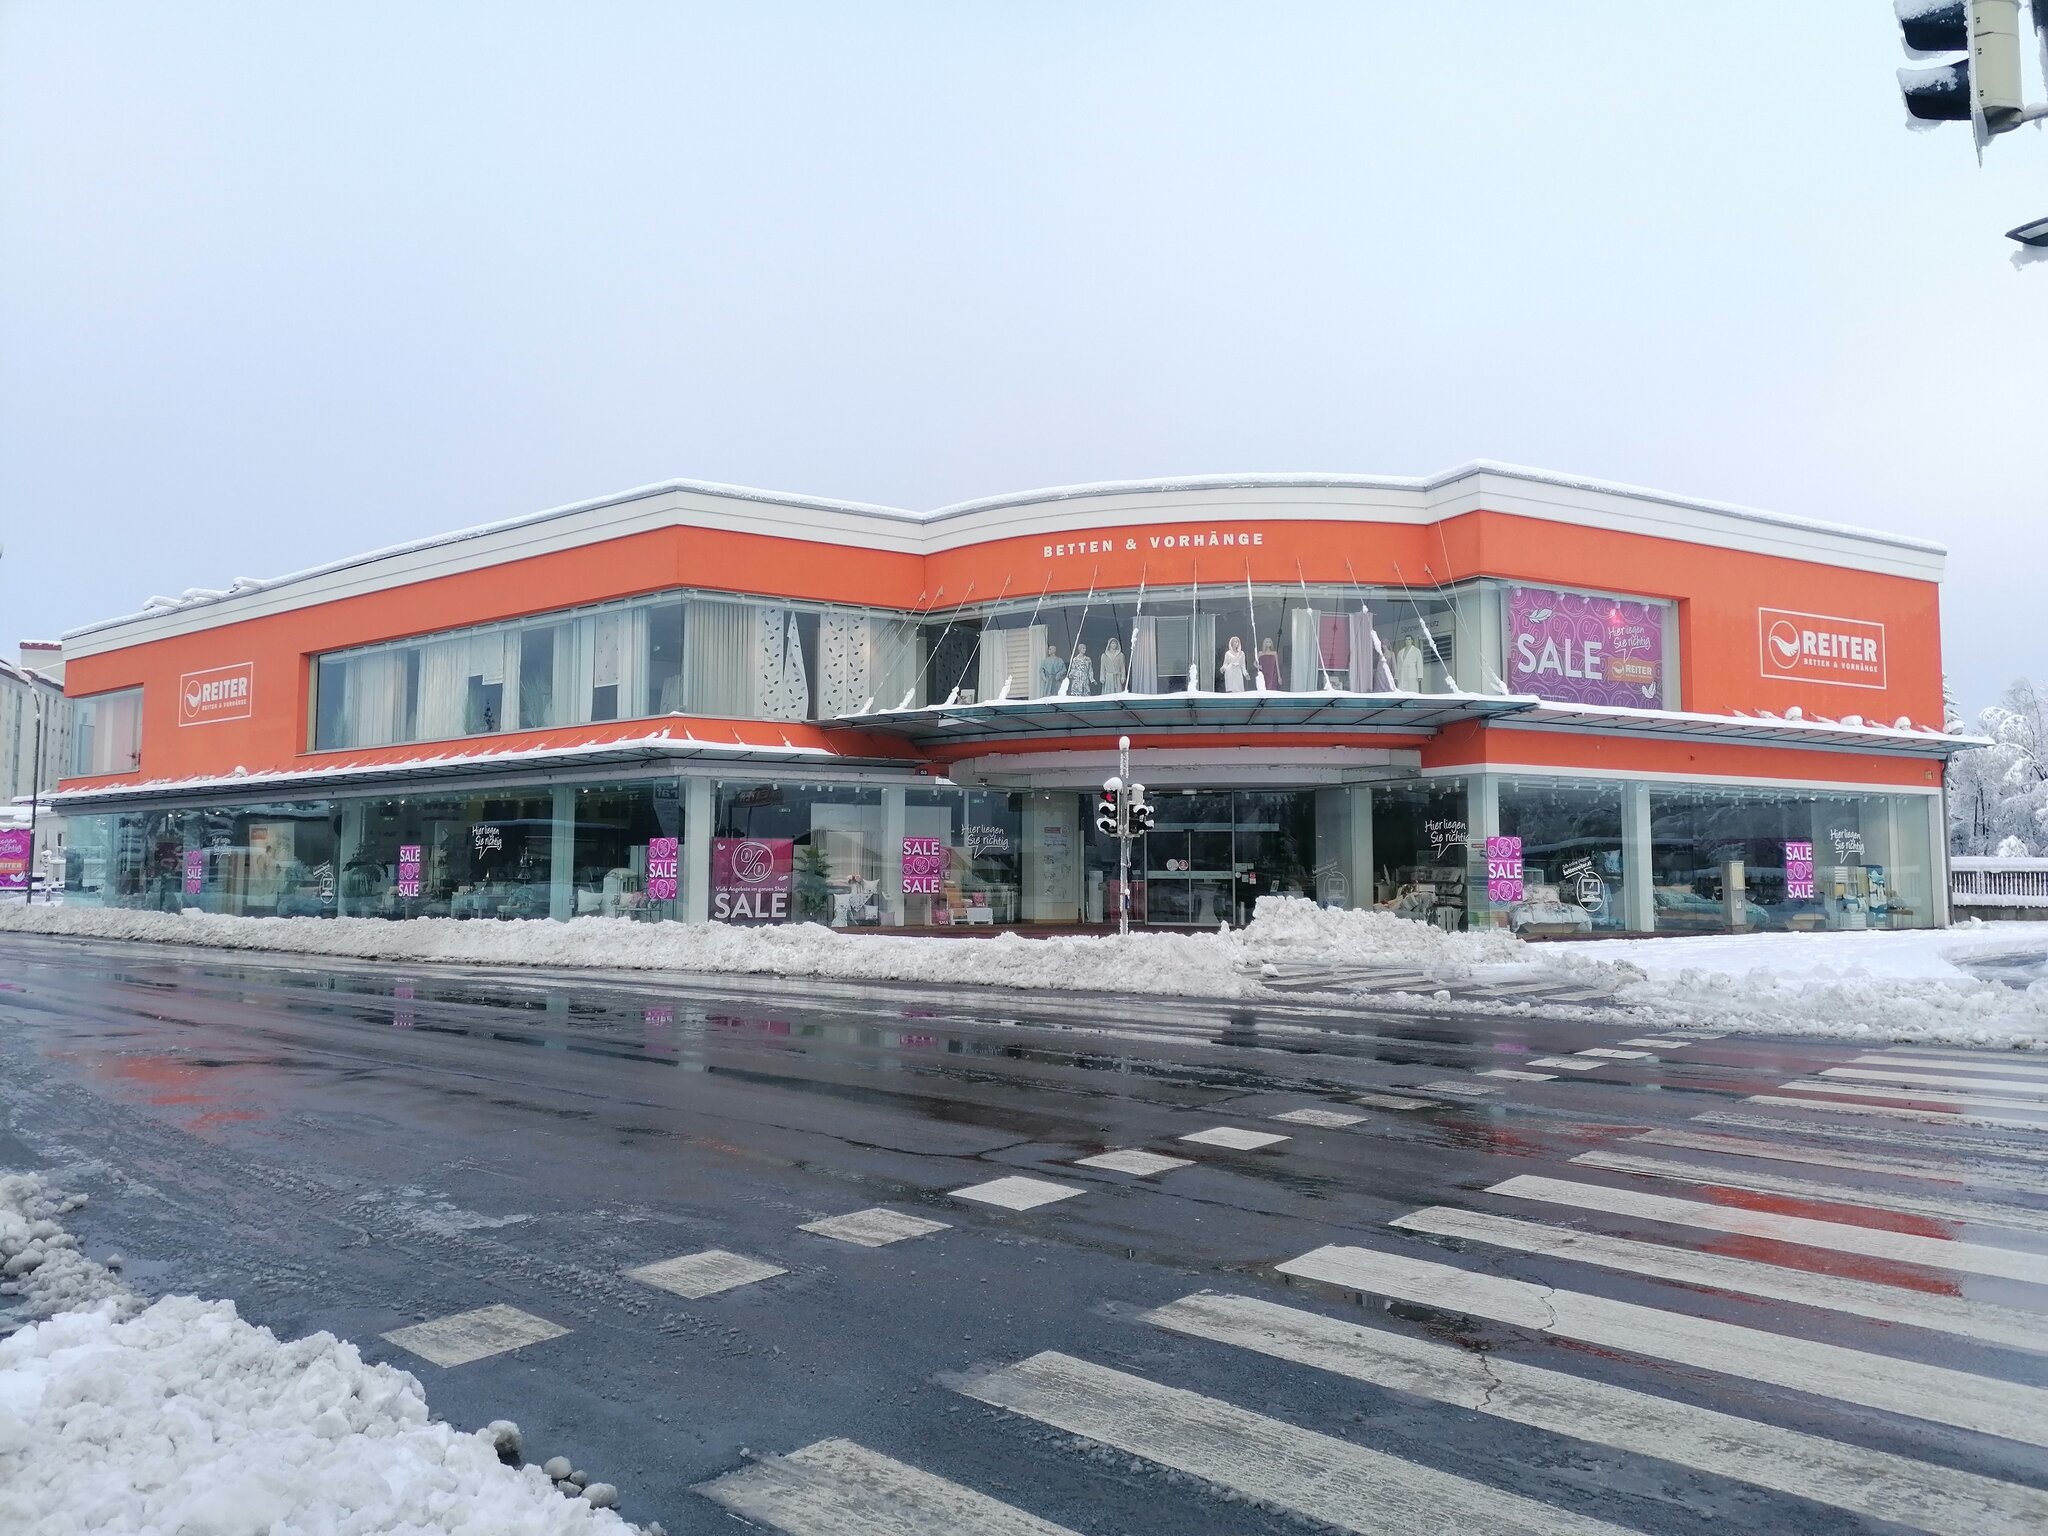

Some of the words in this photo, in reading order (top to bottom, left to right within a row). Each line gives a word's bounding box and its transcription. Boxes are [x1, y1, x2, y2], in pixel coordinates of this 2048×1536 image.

[1043, 540, 1112, 558] BETTEN
[1125, 538, 1137, 550] &
[1150, 531, 1263, 549] VORHÄNGE
[1803, 630, 1877, 662] REITER
[1517, 633, 1603, 680] SALE
[1625, 664, 1653, 676] REITER
[1803, 658, 1830, 667] BETTEN
[1841, 662, 1878, 673] VORHÄNGE
[202, 677, 247, 702] REITER
[961, 823, 981, 835] Hier
[981, 824, 1004, 837] liegen
[1425, 820, 1443, 833] Hier
[1443, 819, 1466, 834] liegen
[967, 834, 981, 845] Sie
[983, 835, 1009, 850] richtig
[1430, 831, 1444, 843] Sie
[400, 849, 420, 862] SALE
[903, 842, 940, 855] SALE
[1786, 846, 1812, 860] SALE
[187, 868, 202, 879] SALE
[649, 862, 677, 878] SALE
[1488, 863, 1522, 879] SALE
[398, 884, 419, 897] SALE
[902, 879, 940, 893] SALE
[1788, 884, 1814, 898] SALE
[714, 893, 788, 919] SALE
